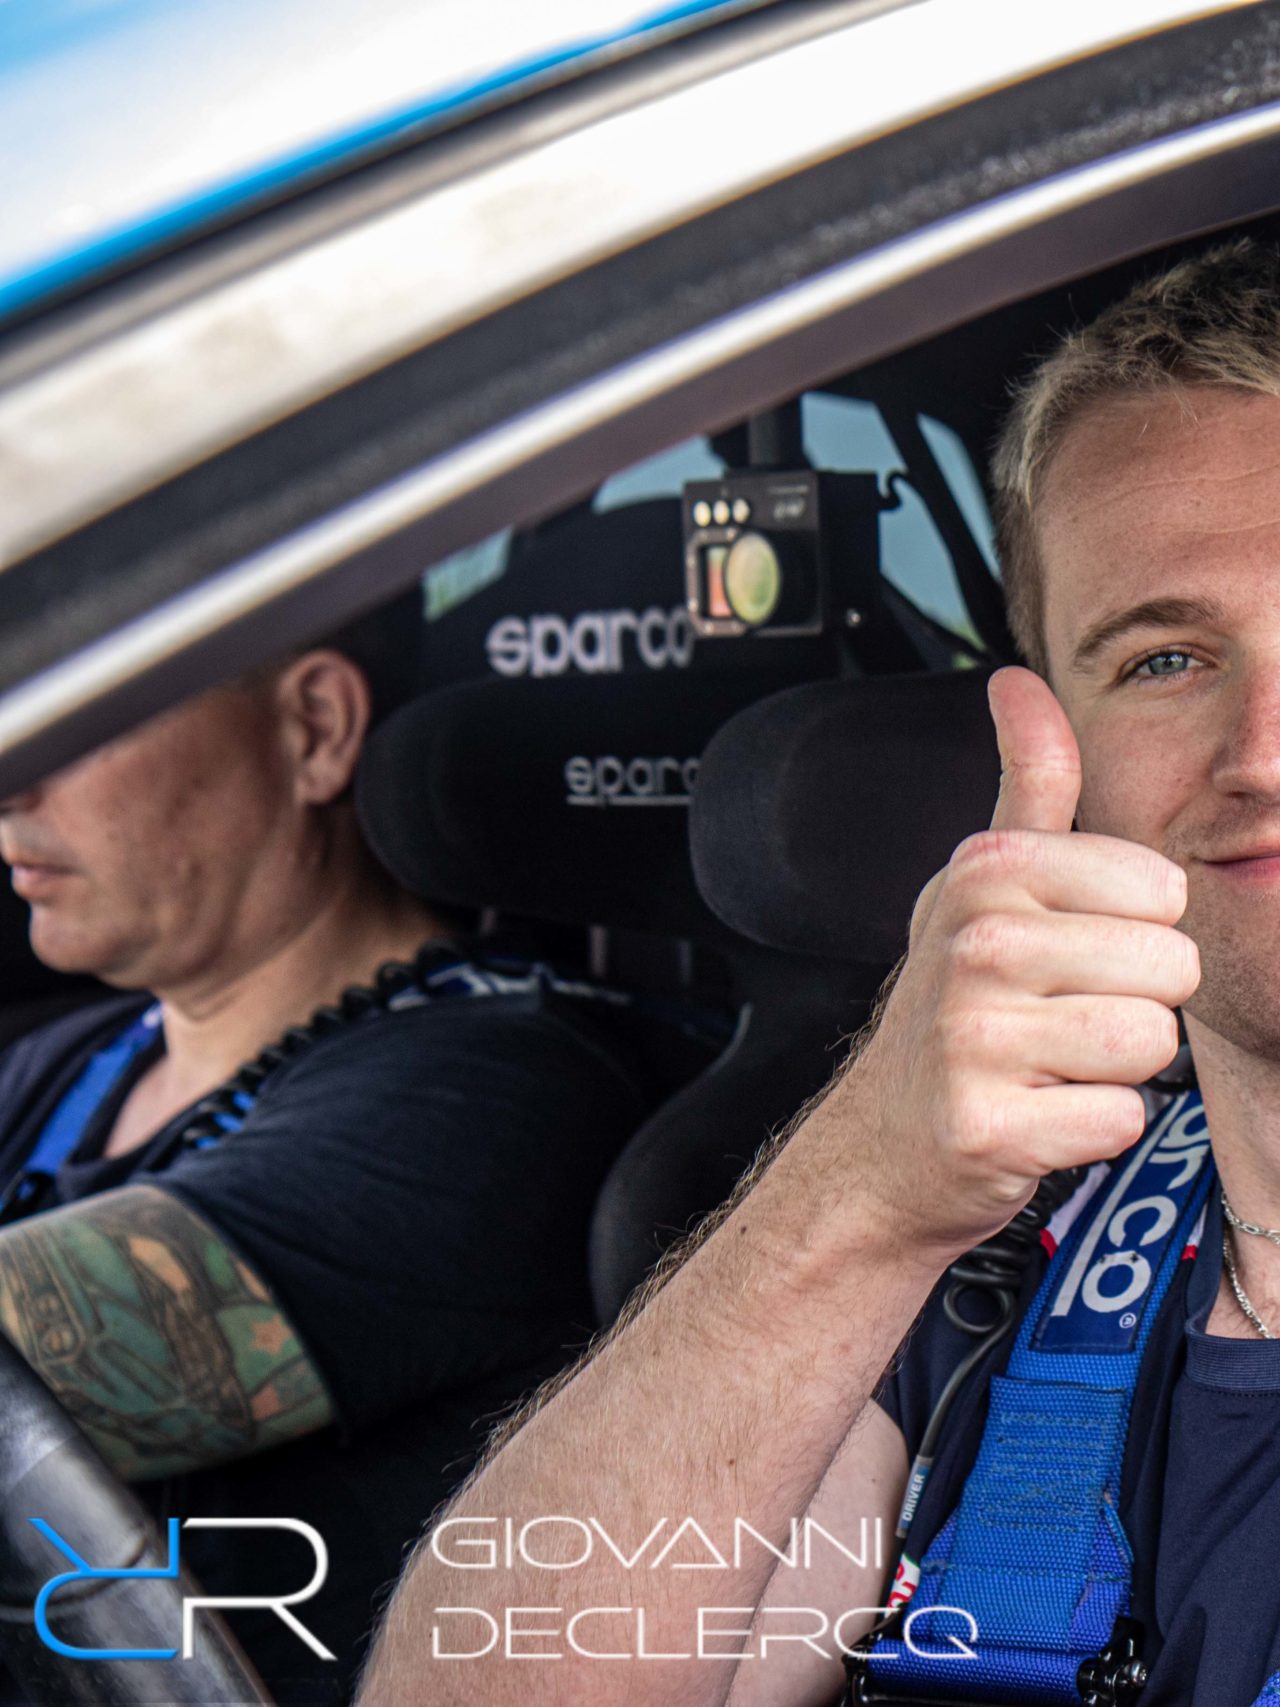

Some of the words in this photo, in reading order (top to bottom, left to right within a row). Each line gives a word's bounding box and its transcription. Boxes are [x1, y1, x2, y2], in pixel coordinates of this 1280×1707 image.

[485, 606, 696, 677] sparco
[565, 755, 700, 808] sparc
[1081, 1104, 1209, 1313] arco
[901, 1473, 926, 1522] DRIVER
